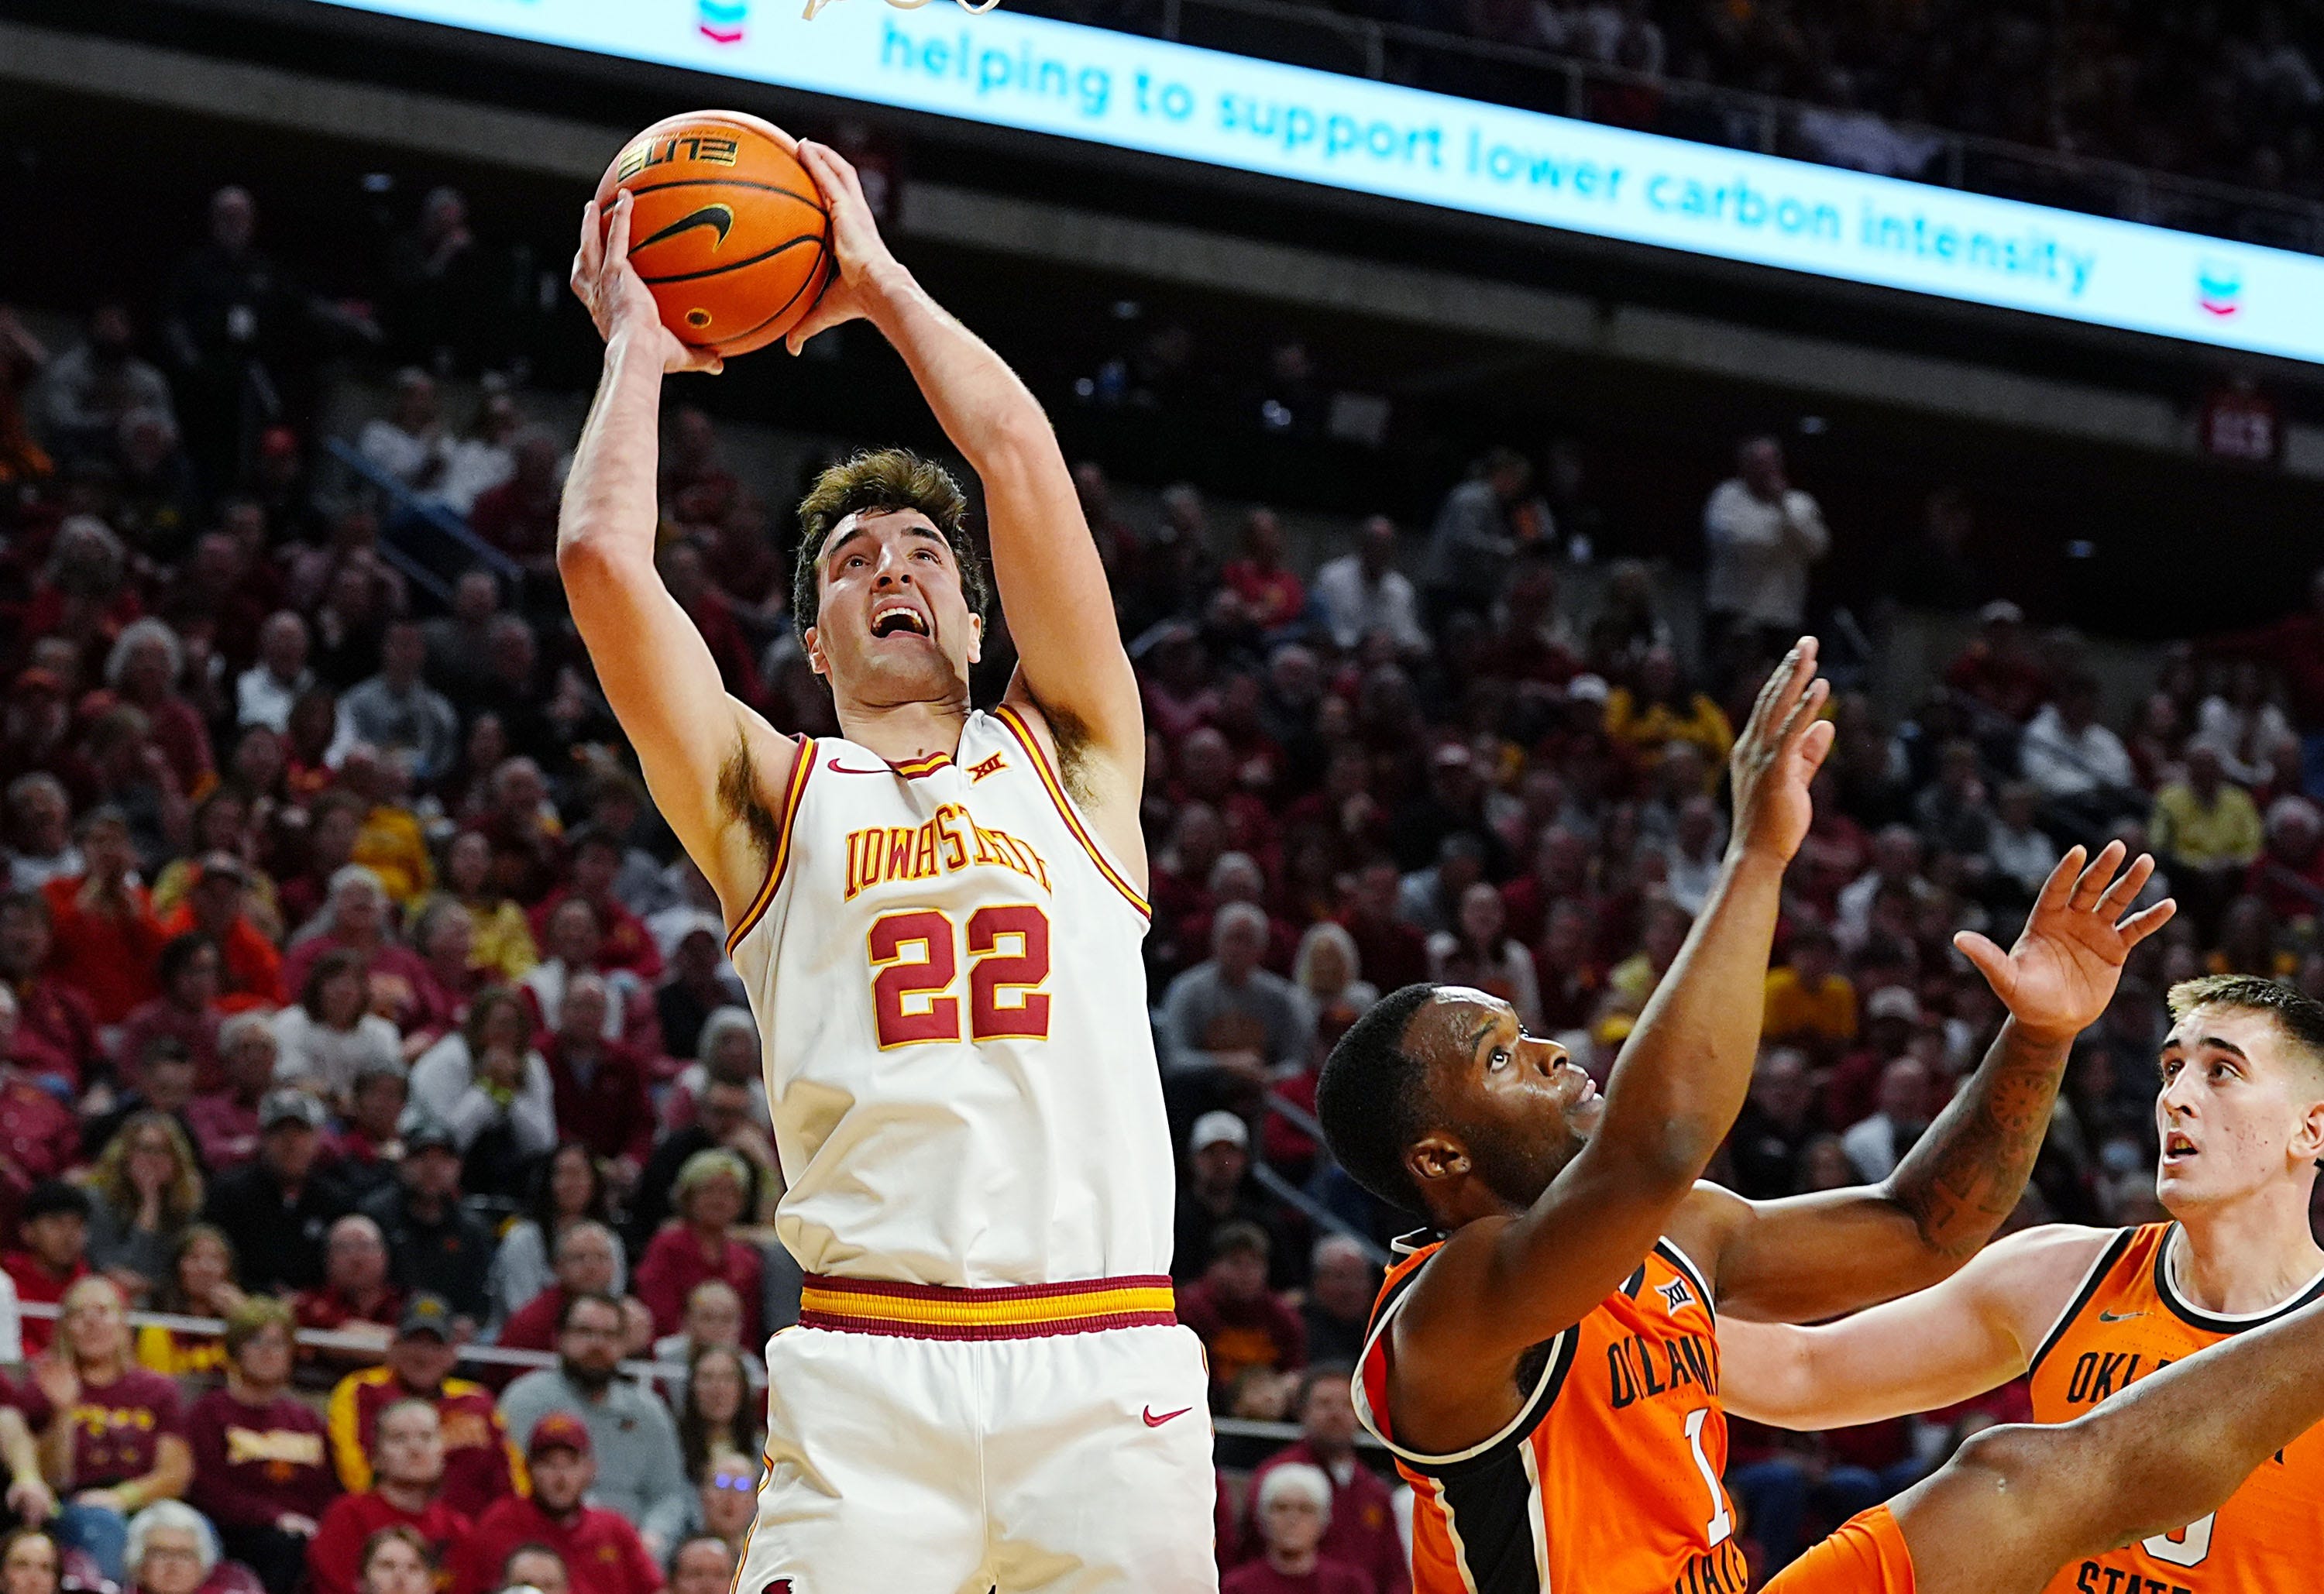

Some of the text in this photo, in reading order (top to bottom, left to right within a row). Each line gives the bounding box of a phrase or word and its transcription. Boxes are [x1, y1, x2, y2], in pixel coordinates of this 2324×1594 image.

[617, 136, 738, 184] ELITE
[878, 19, 2098, 298] helping to support lower carbon intensity
[867, 902, 1051, 1051] 22
[1685, 1407, 1732, 1548] 1
